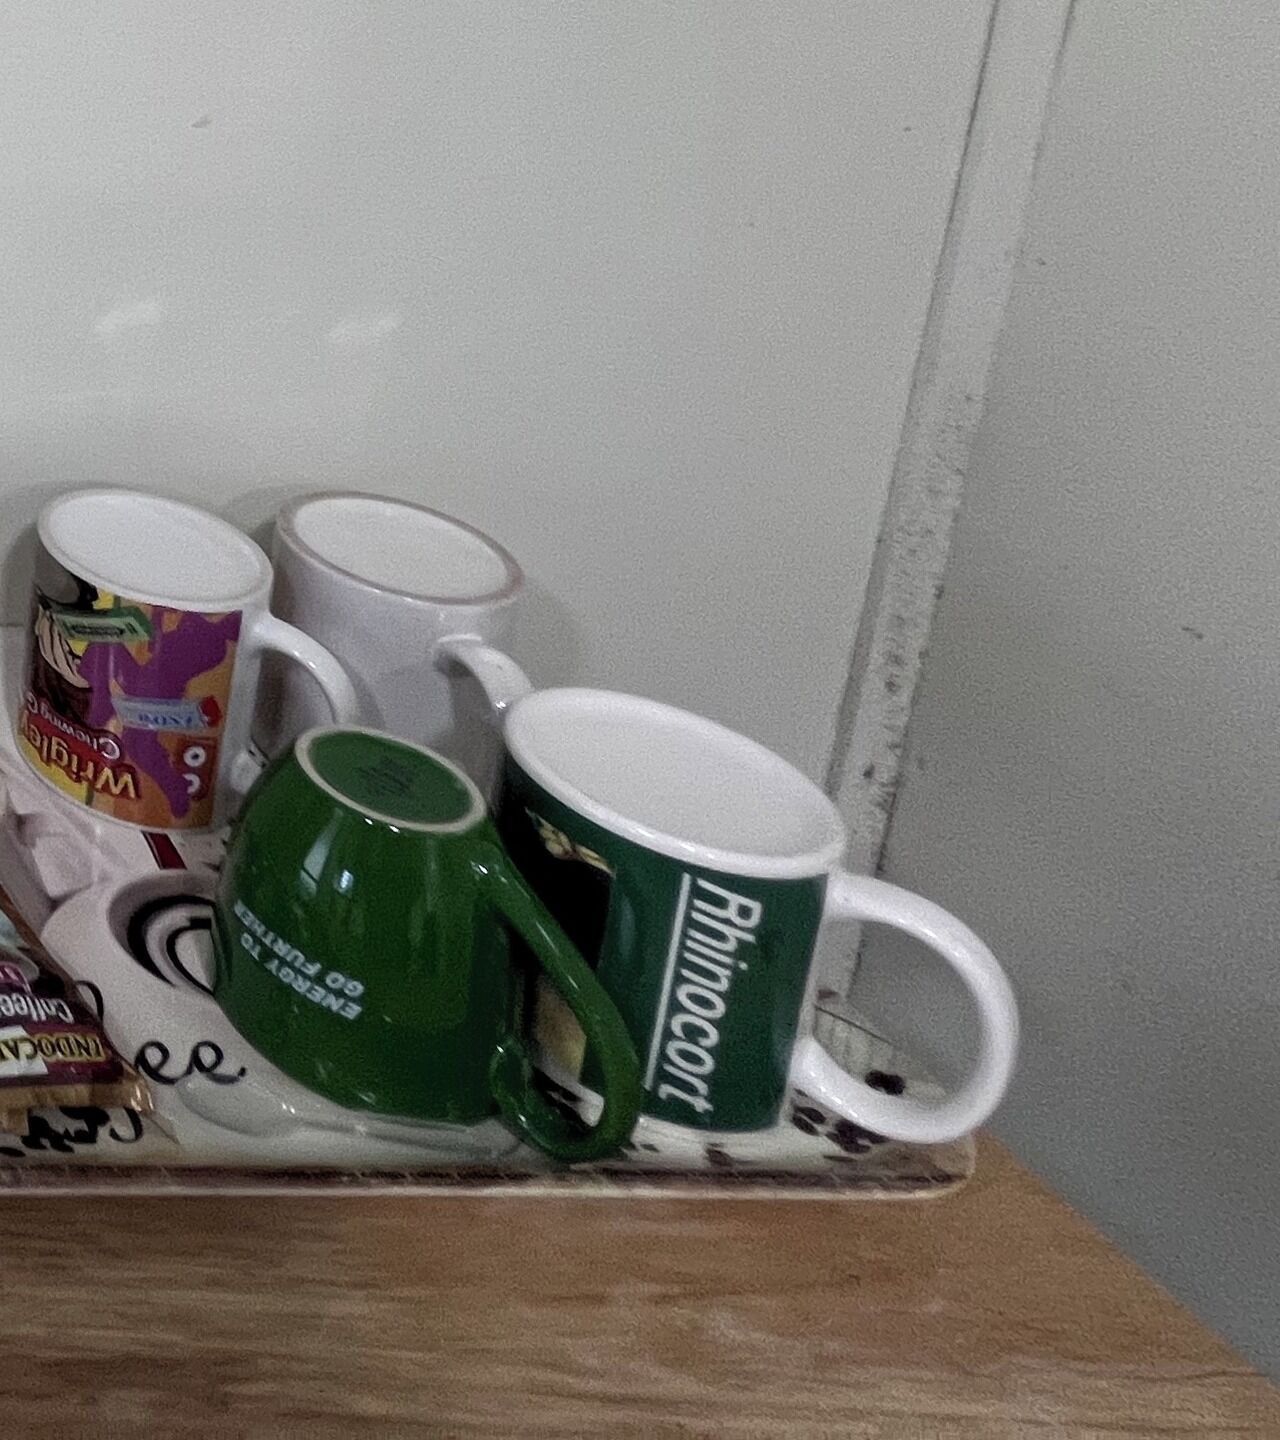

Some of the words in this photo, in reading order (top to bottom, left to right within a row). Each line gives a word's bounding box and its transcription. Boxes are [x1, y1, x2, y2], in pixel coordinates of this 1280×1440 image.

[233, 898, 323, 978] FURTHER
[240, 931, 262, 961] TO
[263, 959, 363, 1021] ENERGY
[324, 970, 365, 998] GO
[657, 877, 763, 1114] Rhinocort
